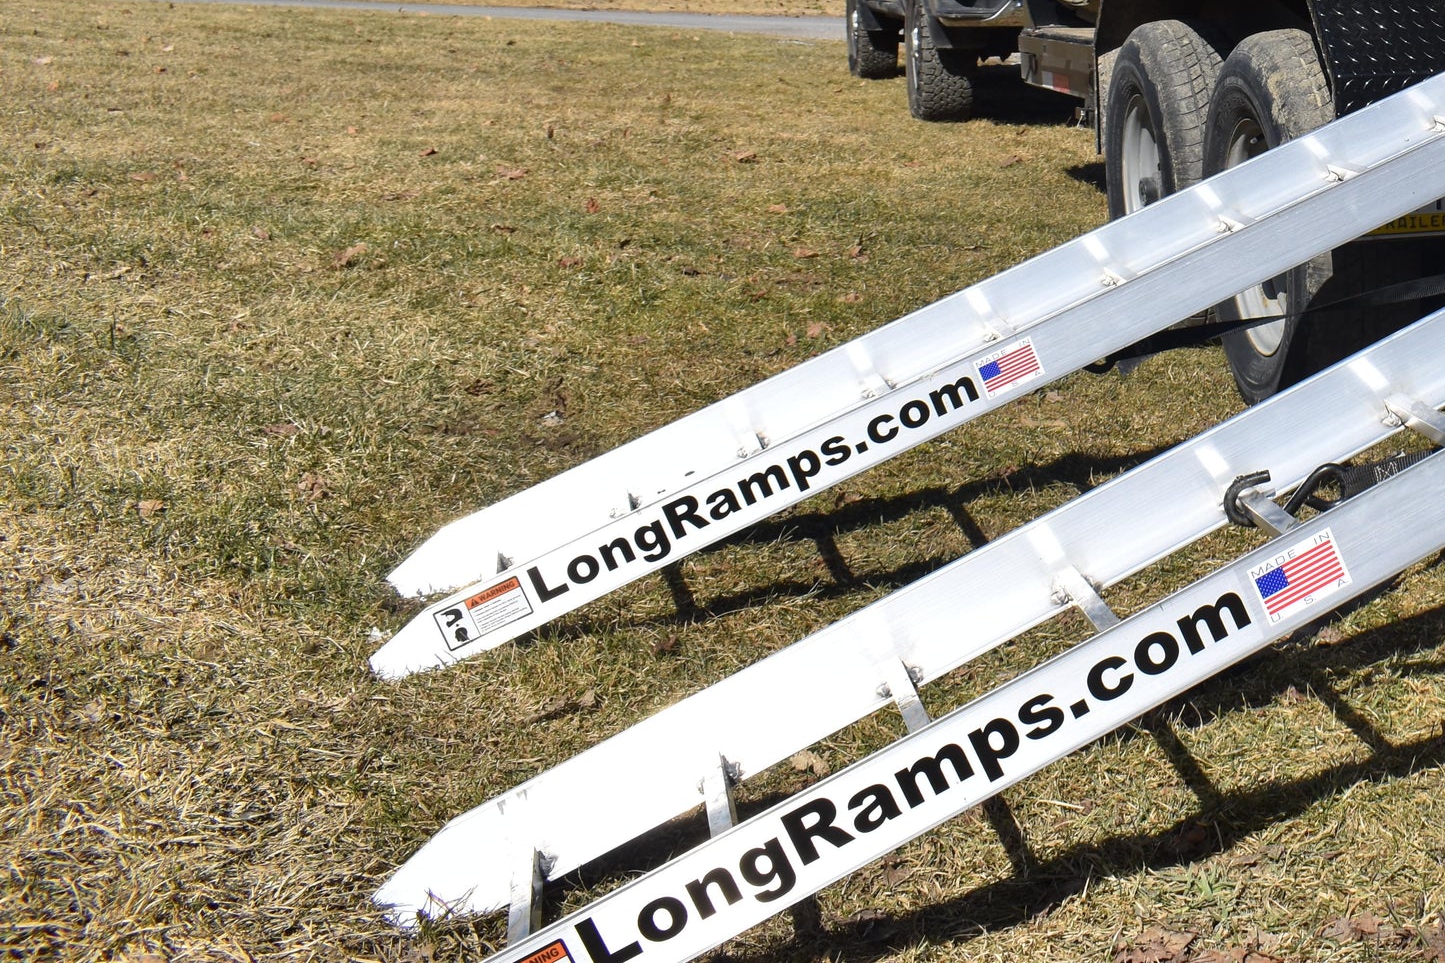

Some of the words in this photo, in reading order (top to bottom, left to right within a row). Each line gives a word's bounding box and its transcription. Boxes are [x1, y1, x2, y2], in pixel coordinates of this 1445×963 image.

[975, 349, 1007, 368] MADE
[528, 377, 980, 603] LongRamps.com
[1250, 549, 1297, 579] MADE
[1313, 531, 1330, 546] IN
[479, 580, 515, 602] WARNING
[574, 592, 1252, 963] LongRamps.com
